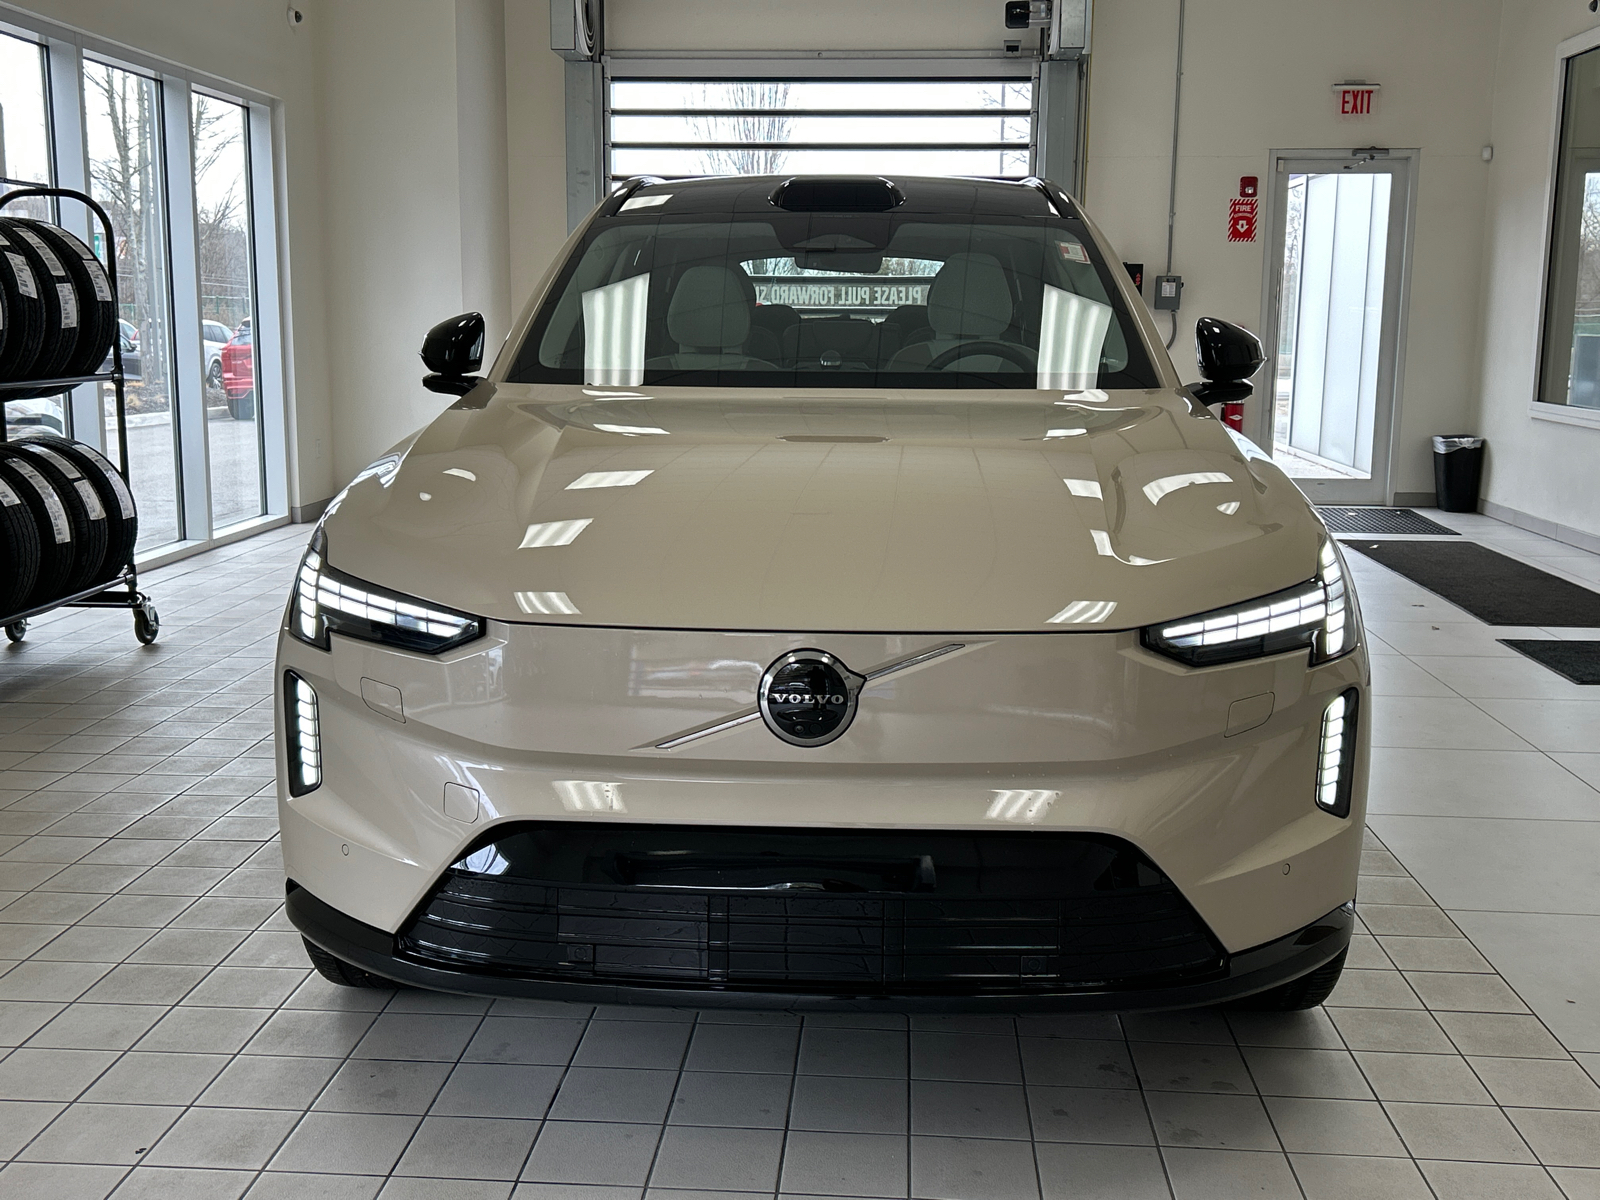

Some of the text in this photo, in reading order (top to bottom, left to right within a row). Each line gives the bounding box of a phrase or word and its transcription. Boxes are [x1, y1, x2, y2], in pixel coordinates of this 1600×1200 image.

[1341, 90, 1374, 114] EXIT
[1235, 204, 1252, 212] FIRE
[771, 693, 844, 704] VOLVO
